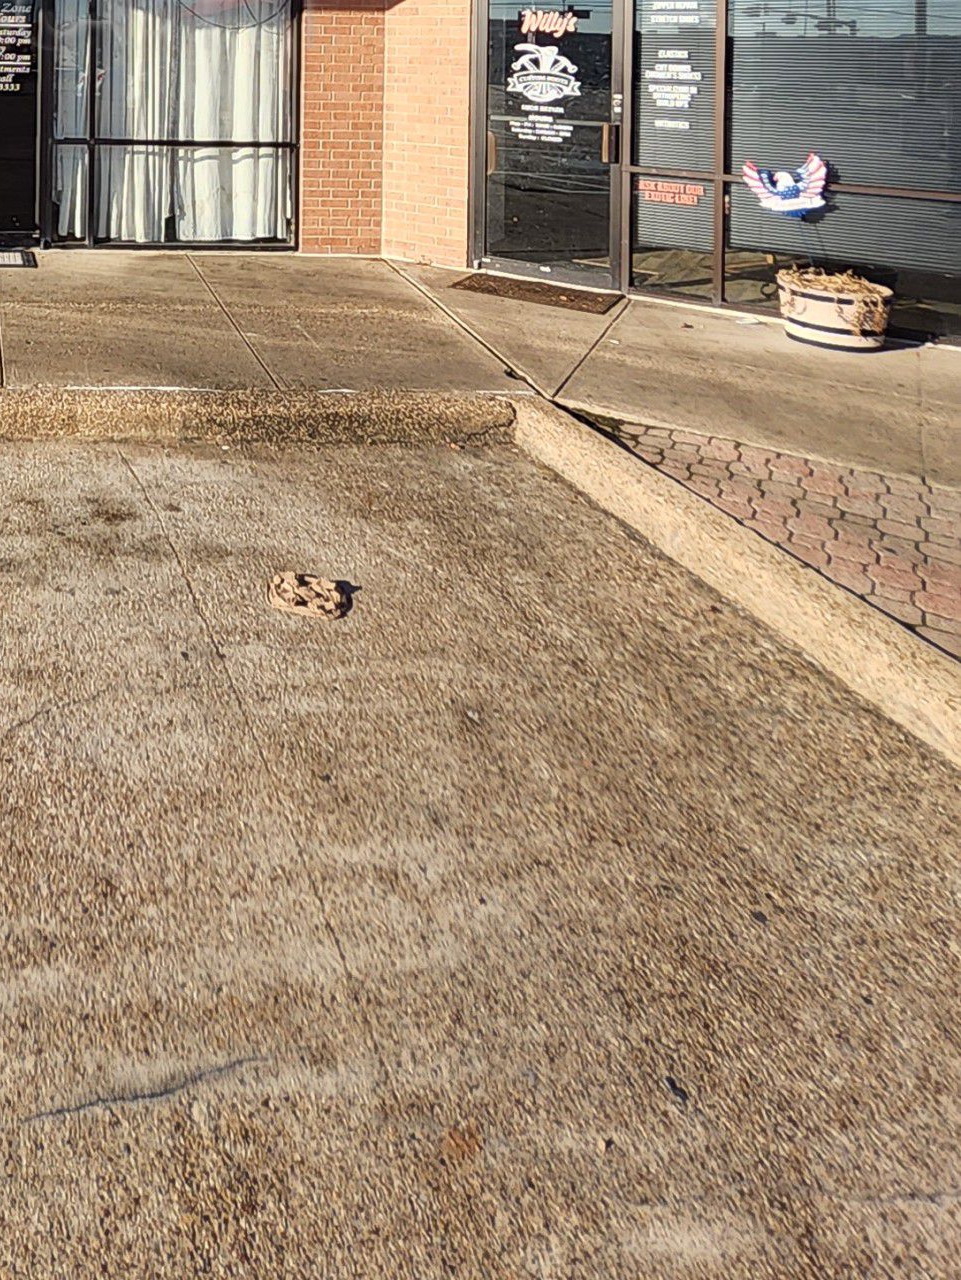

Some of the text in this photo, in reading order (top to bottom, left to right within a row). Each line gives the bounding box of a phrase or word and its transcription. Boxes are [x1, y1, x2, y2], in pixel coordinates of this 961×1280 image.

[1, 3, 31, 13] Zone
[521, 8, 577, 38] Willy's
[17, 38, 31, 47] pm
